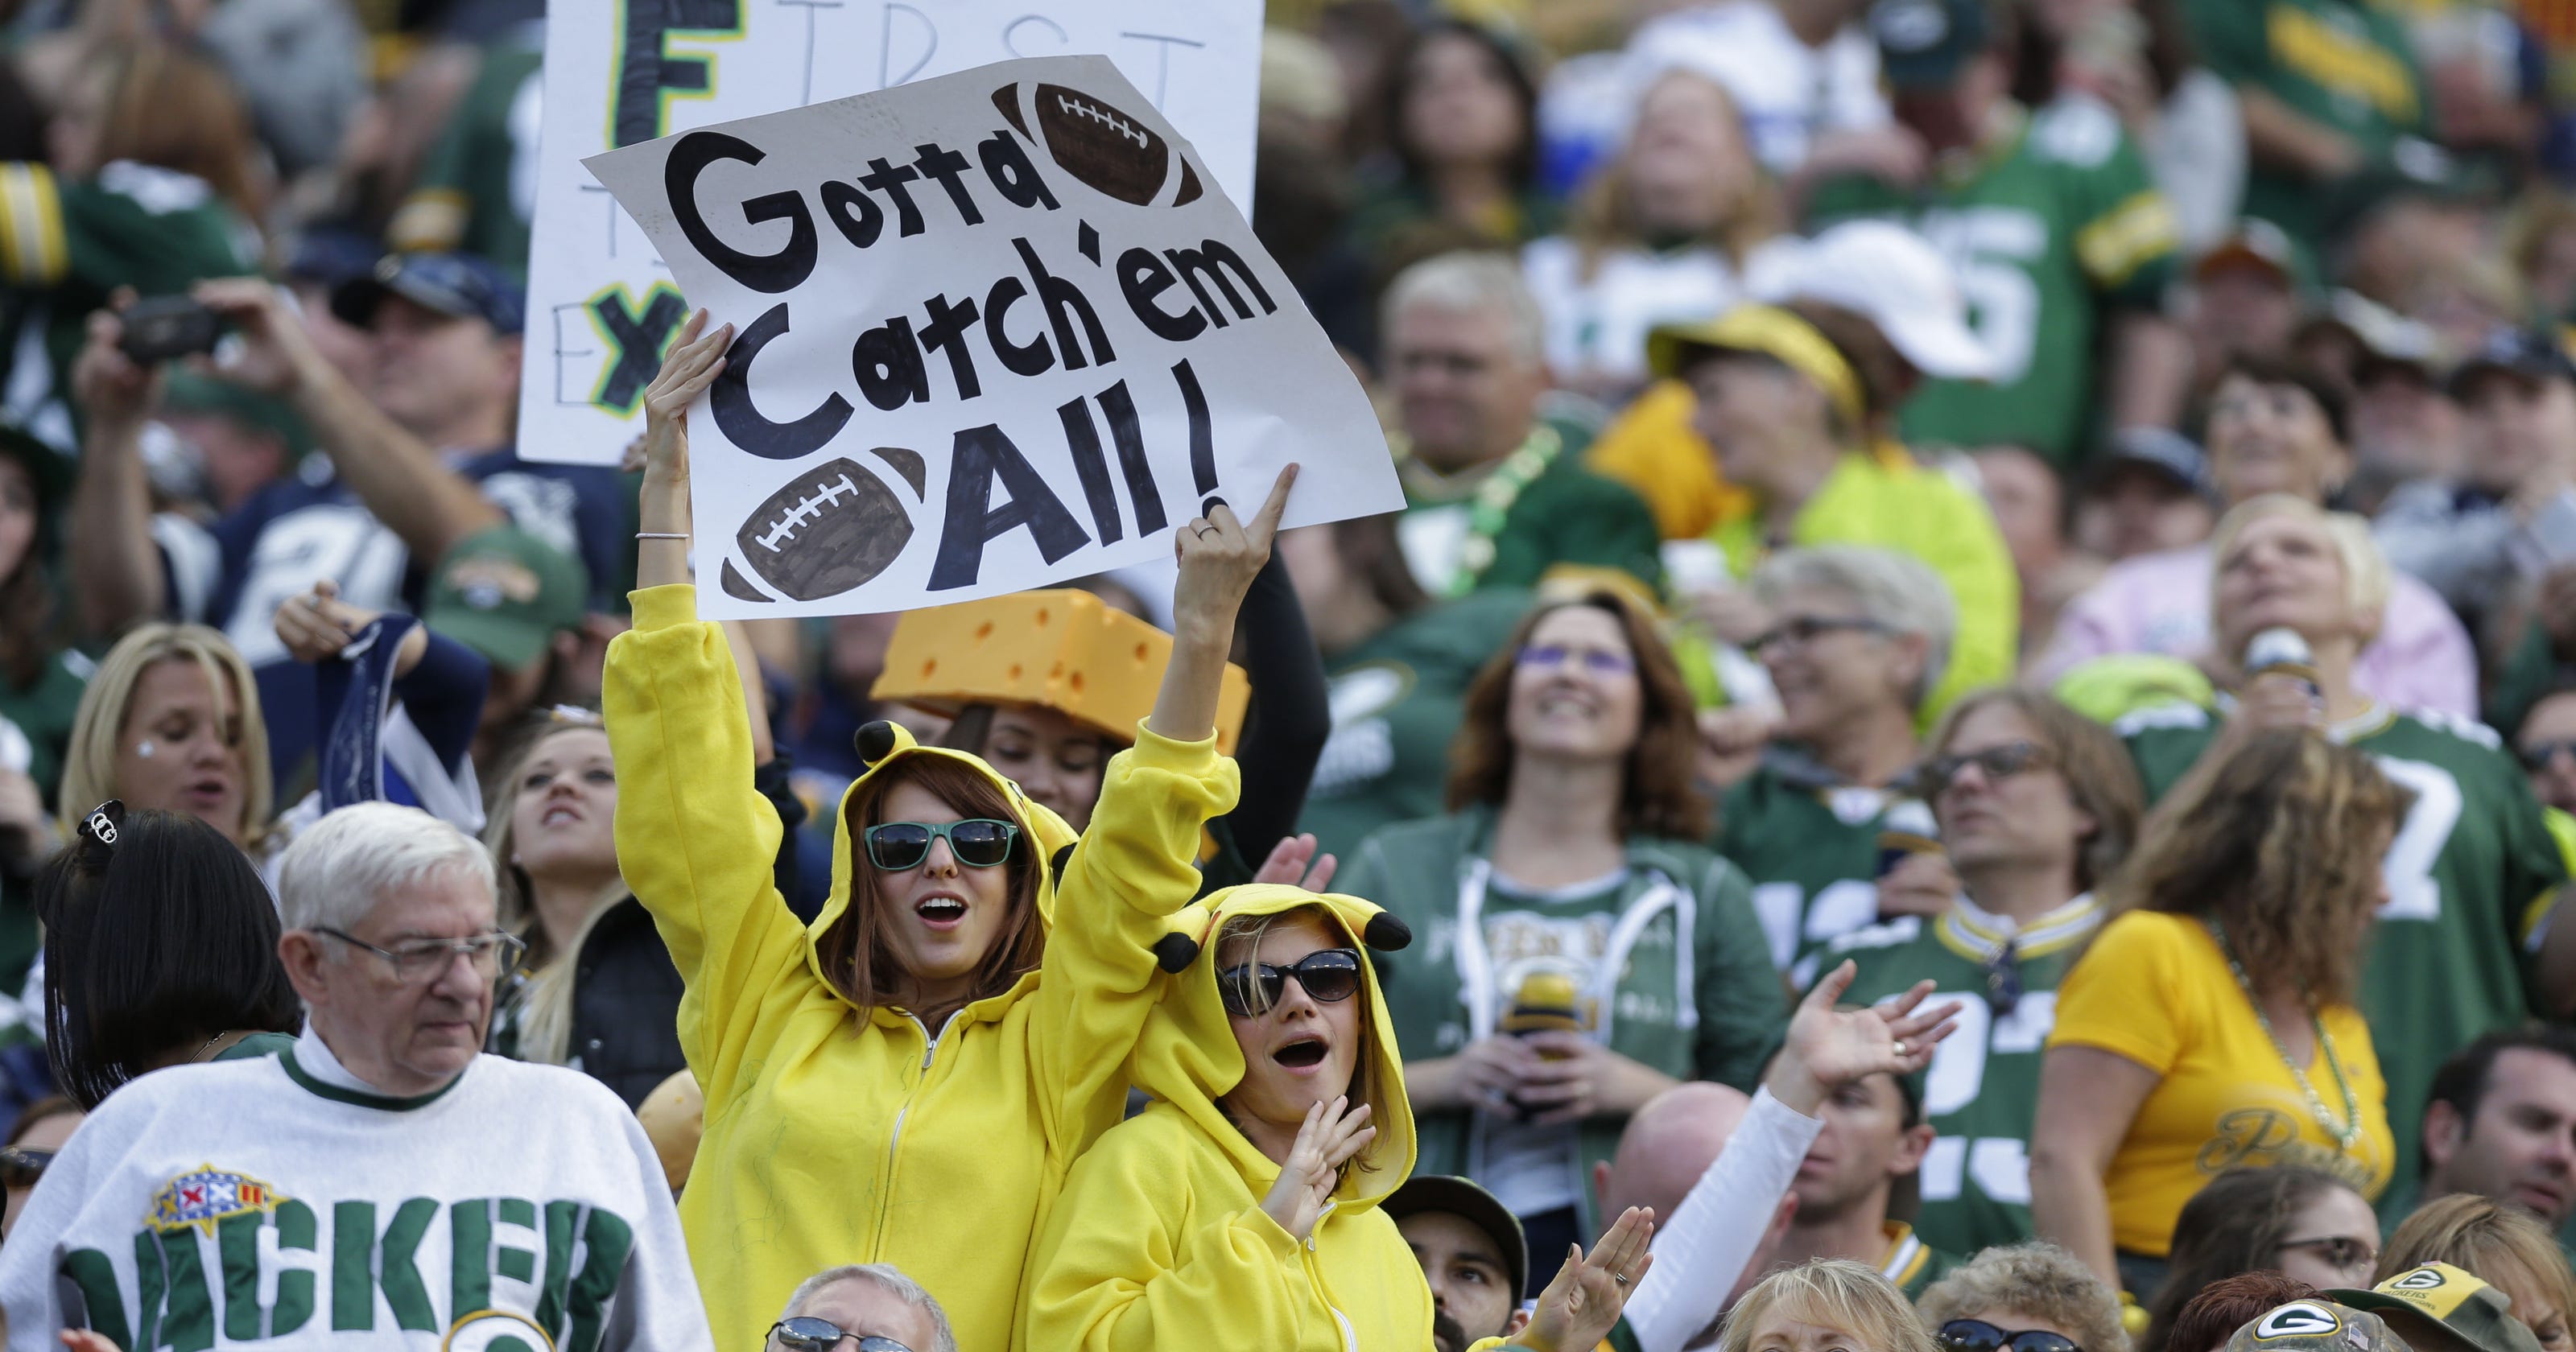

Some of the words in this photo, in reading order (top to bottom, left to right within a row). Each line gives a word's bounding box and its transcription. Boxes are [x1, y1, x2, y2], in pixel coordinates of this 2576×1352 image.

[664, 130, 1062, 294] Gotta
[710, 237, 1117, 460] Catch
[1079, 219, 1278, 342] 'em
